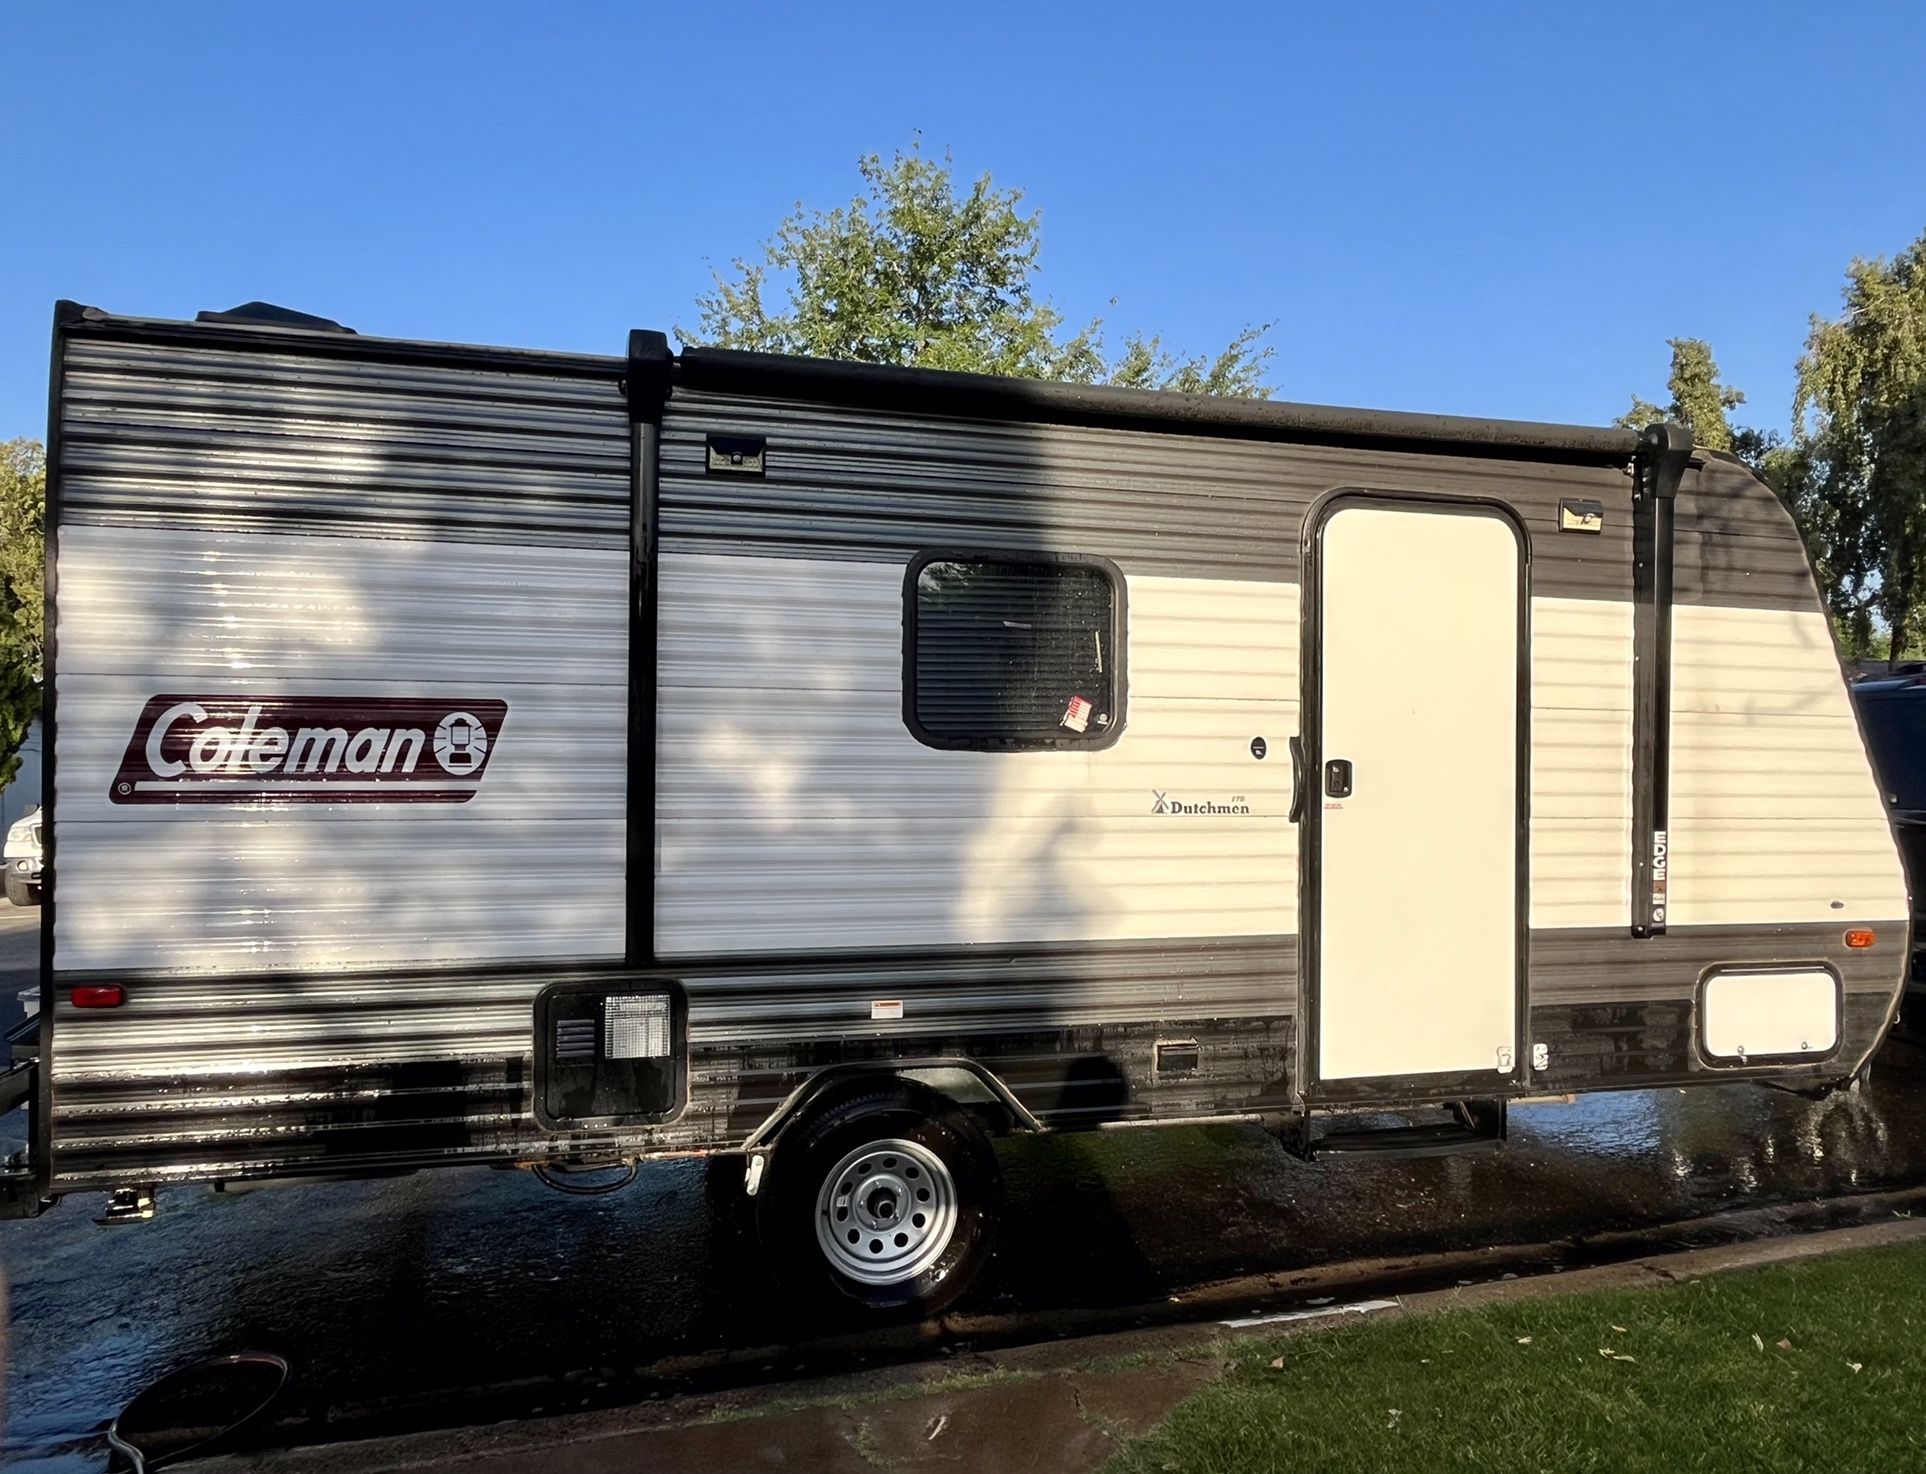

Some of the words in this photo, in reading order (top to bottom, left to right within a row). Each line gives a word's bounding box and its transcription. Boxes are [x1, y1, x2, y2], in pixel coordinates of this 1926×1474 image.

[145, 702, 426, 778] Coleman
[1170, 801, 1250, 814] Dutchmen
[1653, 830, 1666, 881] EDGE
